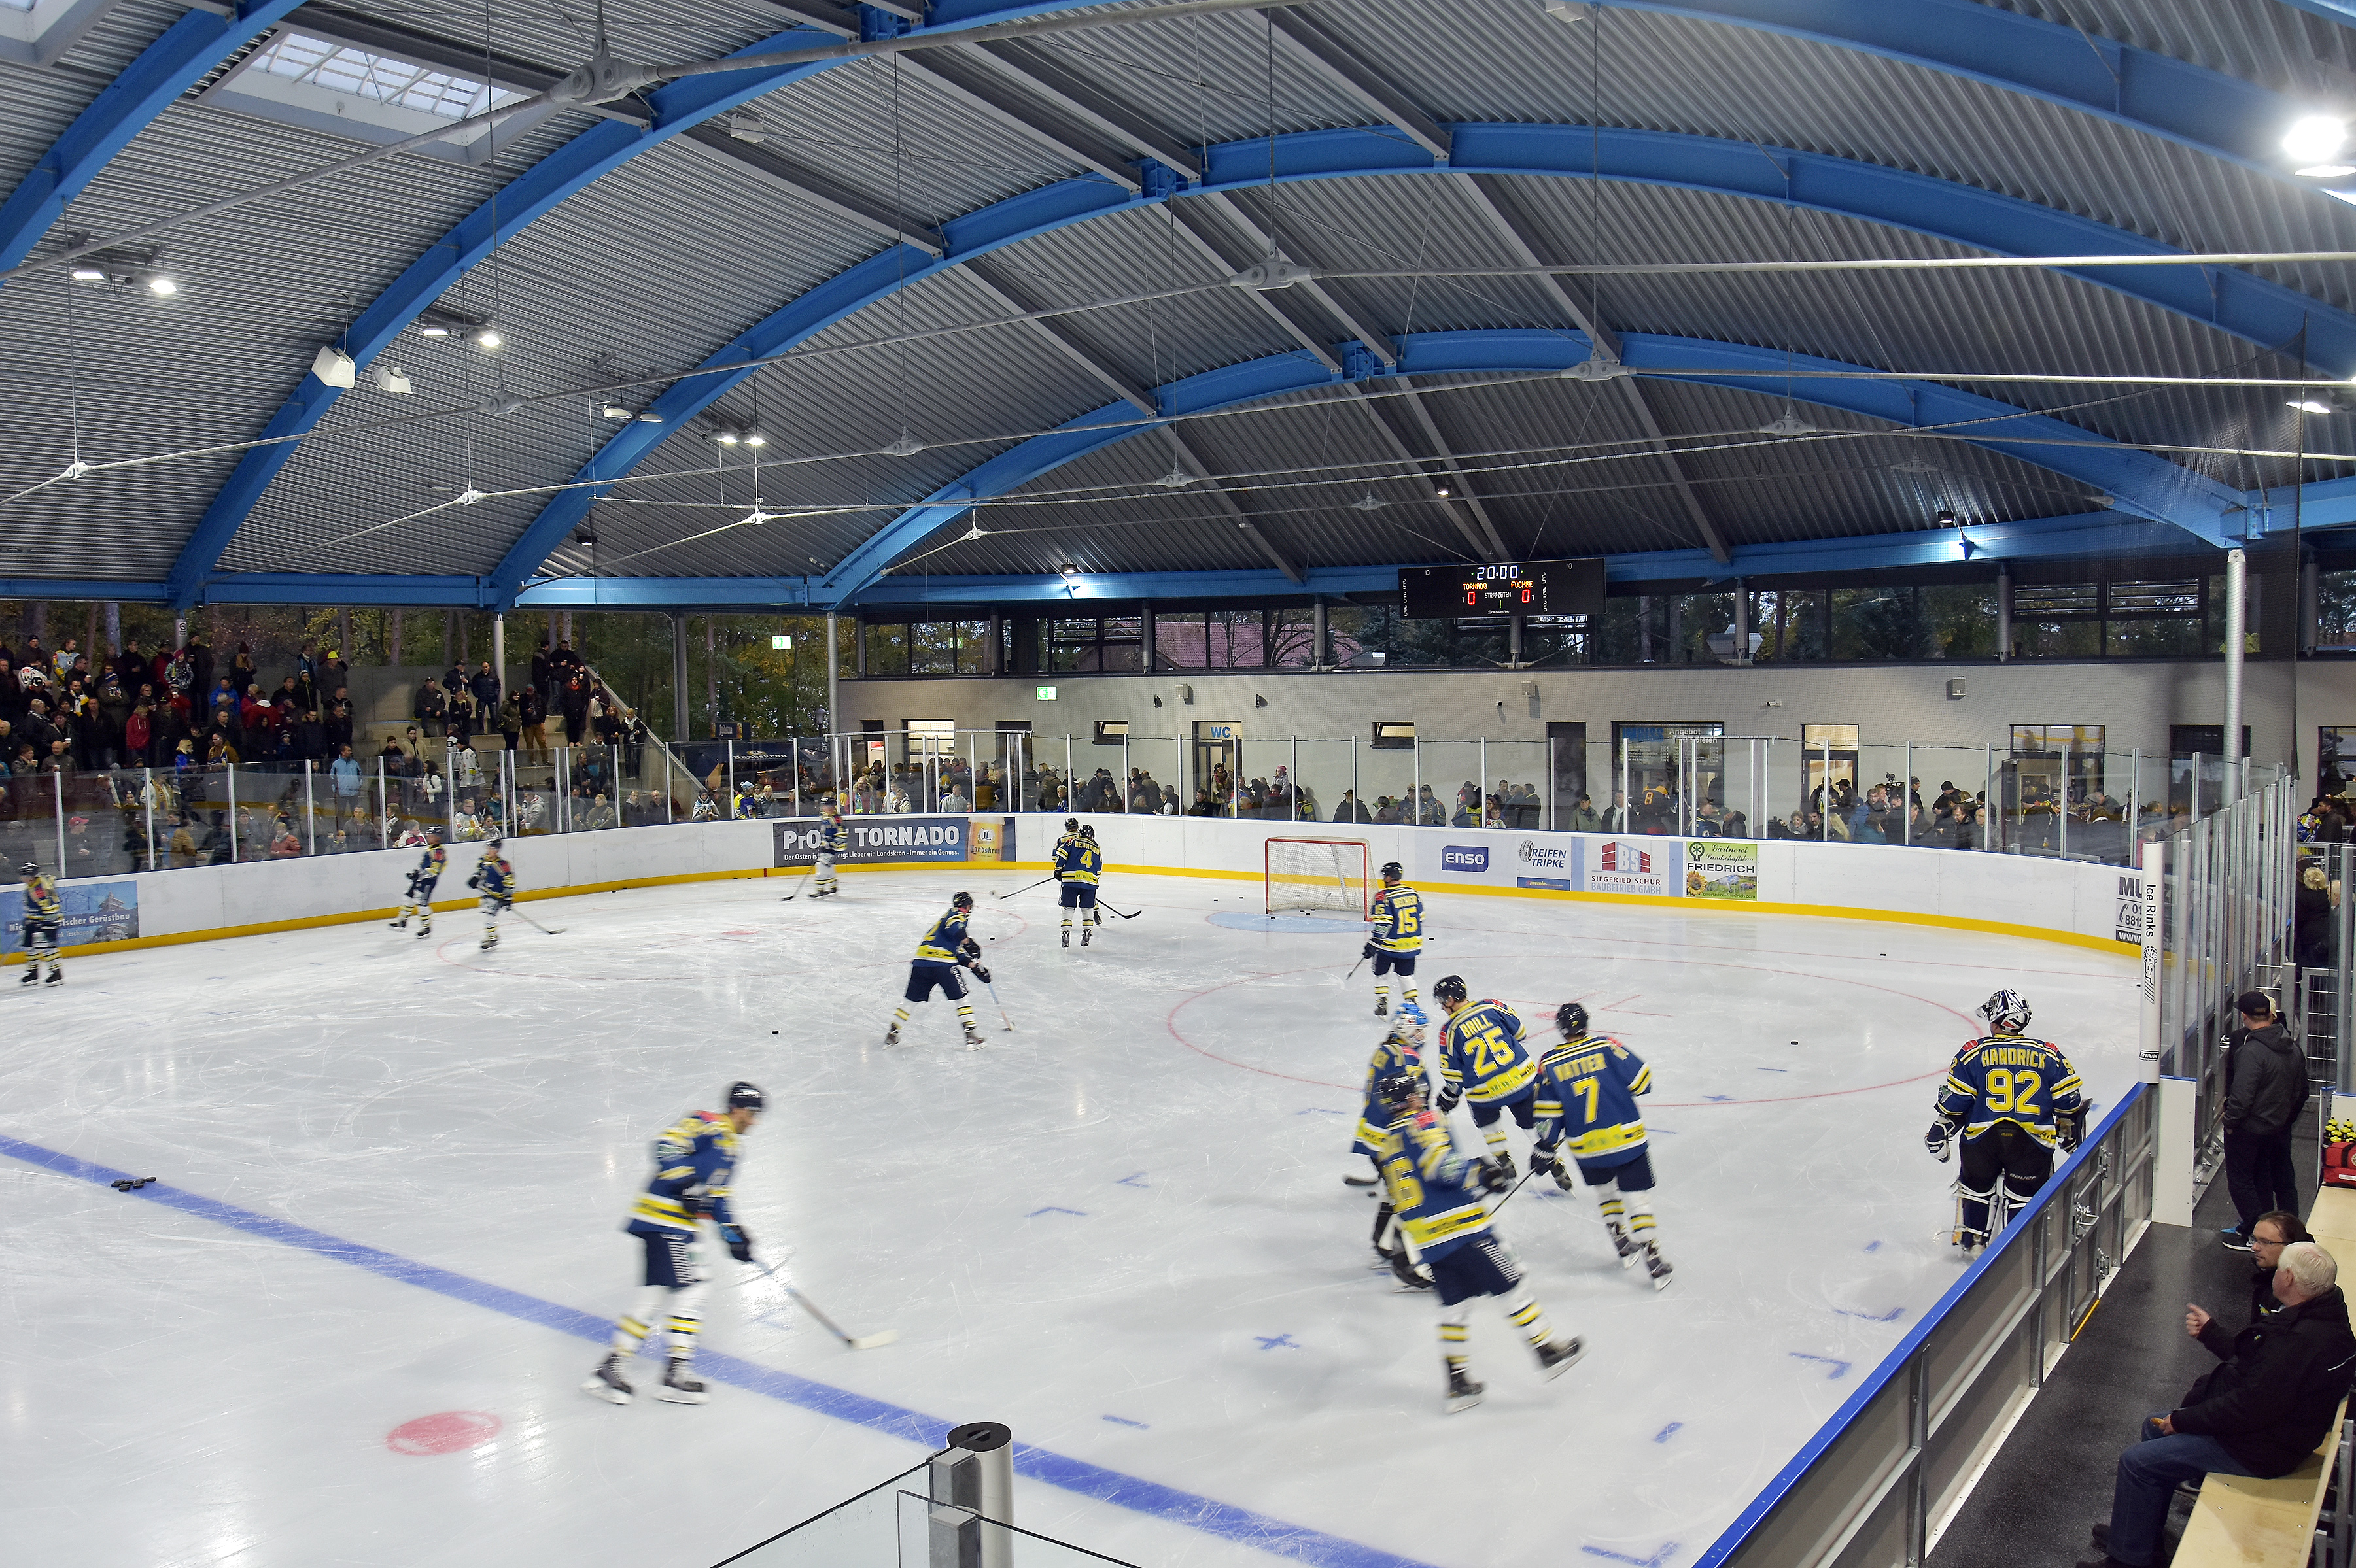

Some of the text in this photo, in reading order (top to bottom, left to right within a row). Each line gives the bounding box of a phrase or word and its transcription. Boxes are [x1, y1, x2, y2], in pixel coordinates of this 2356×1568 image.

[1510, 580, 1533, 588] FÜCHSE
[1467, 591, 1476, 605] 0
[1521, 589, 1531, 604] 0
[1211, 726, 1231, 738] WC
[783, 826, 960, 850] PrO TORNADO
[1532, 849, 1567, 859] REIFEN
[1711, 844, 1748, 853] Gärtnerei
[1080, 849, 1093, 868] 4
[1532, 859, 1565, 868] TRIPKE
[1618, 844, 1640, 872] BS
[1705, 853, 1754, 863] Landschaftsbau
[1688, 863, 1755, 873] FRIEDRICH
[1591, 883, 1661, 894] BAUBETRIEB GMBH
[89, 914, 130, 923] Gerüstbau
[2146, 885, 2156, 937] Ice Rinks
[1397, 907, 1418, 934] 15
[1459, 1014, 1493, 1039] BRILL
[1463, 1027, 1516, 1078] 25
[1981, 1048, 2047, 1070] HANDRICK
[1986, 1068, 2041, 1116] 92
[1571, 1076, 1600, 1125] 7
